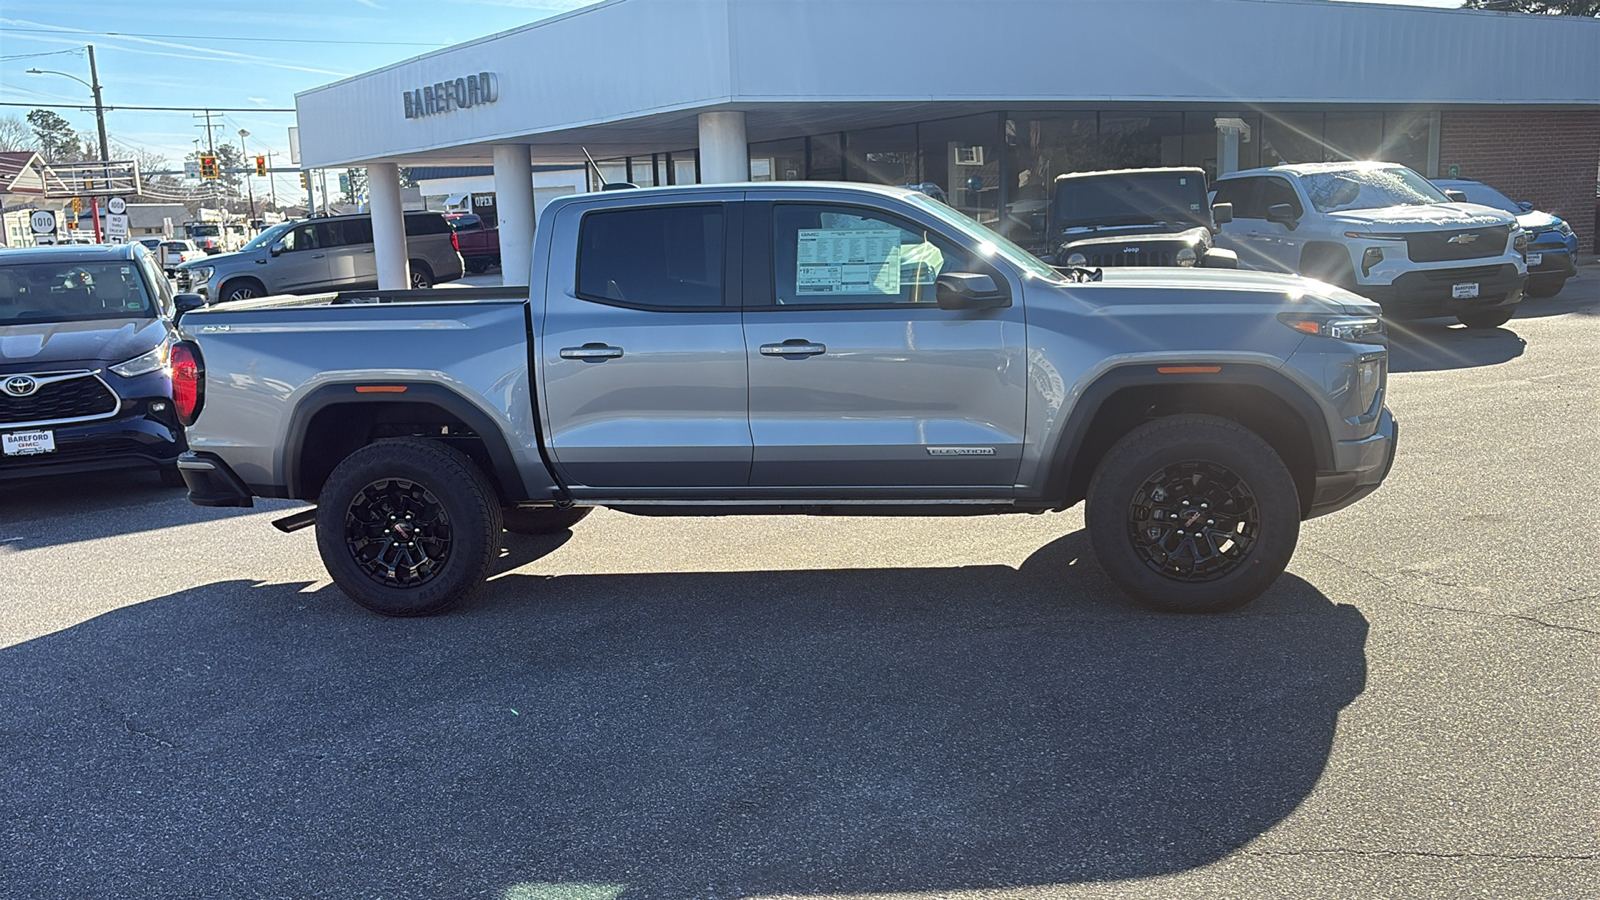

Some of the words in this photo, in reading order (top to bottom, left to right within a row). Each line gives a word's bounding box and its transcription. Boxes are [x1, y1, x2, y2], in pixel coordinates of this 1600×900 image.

[403, 72, 498, 119] BAREFORD
[111, 201, 124, 209] 1008
[475, 196, 493, 207] OPEN
[34, 217, 52, 227] 1010
[8, 434, 48, 443] BAREFORD
